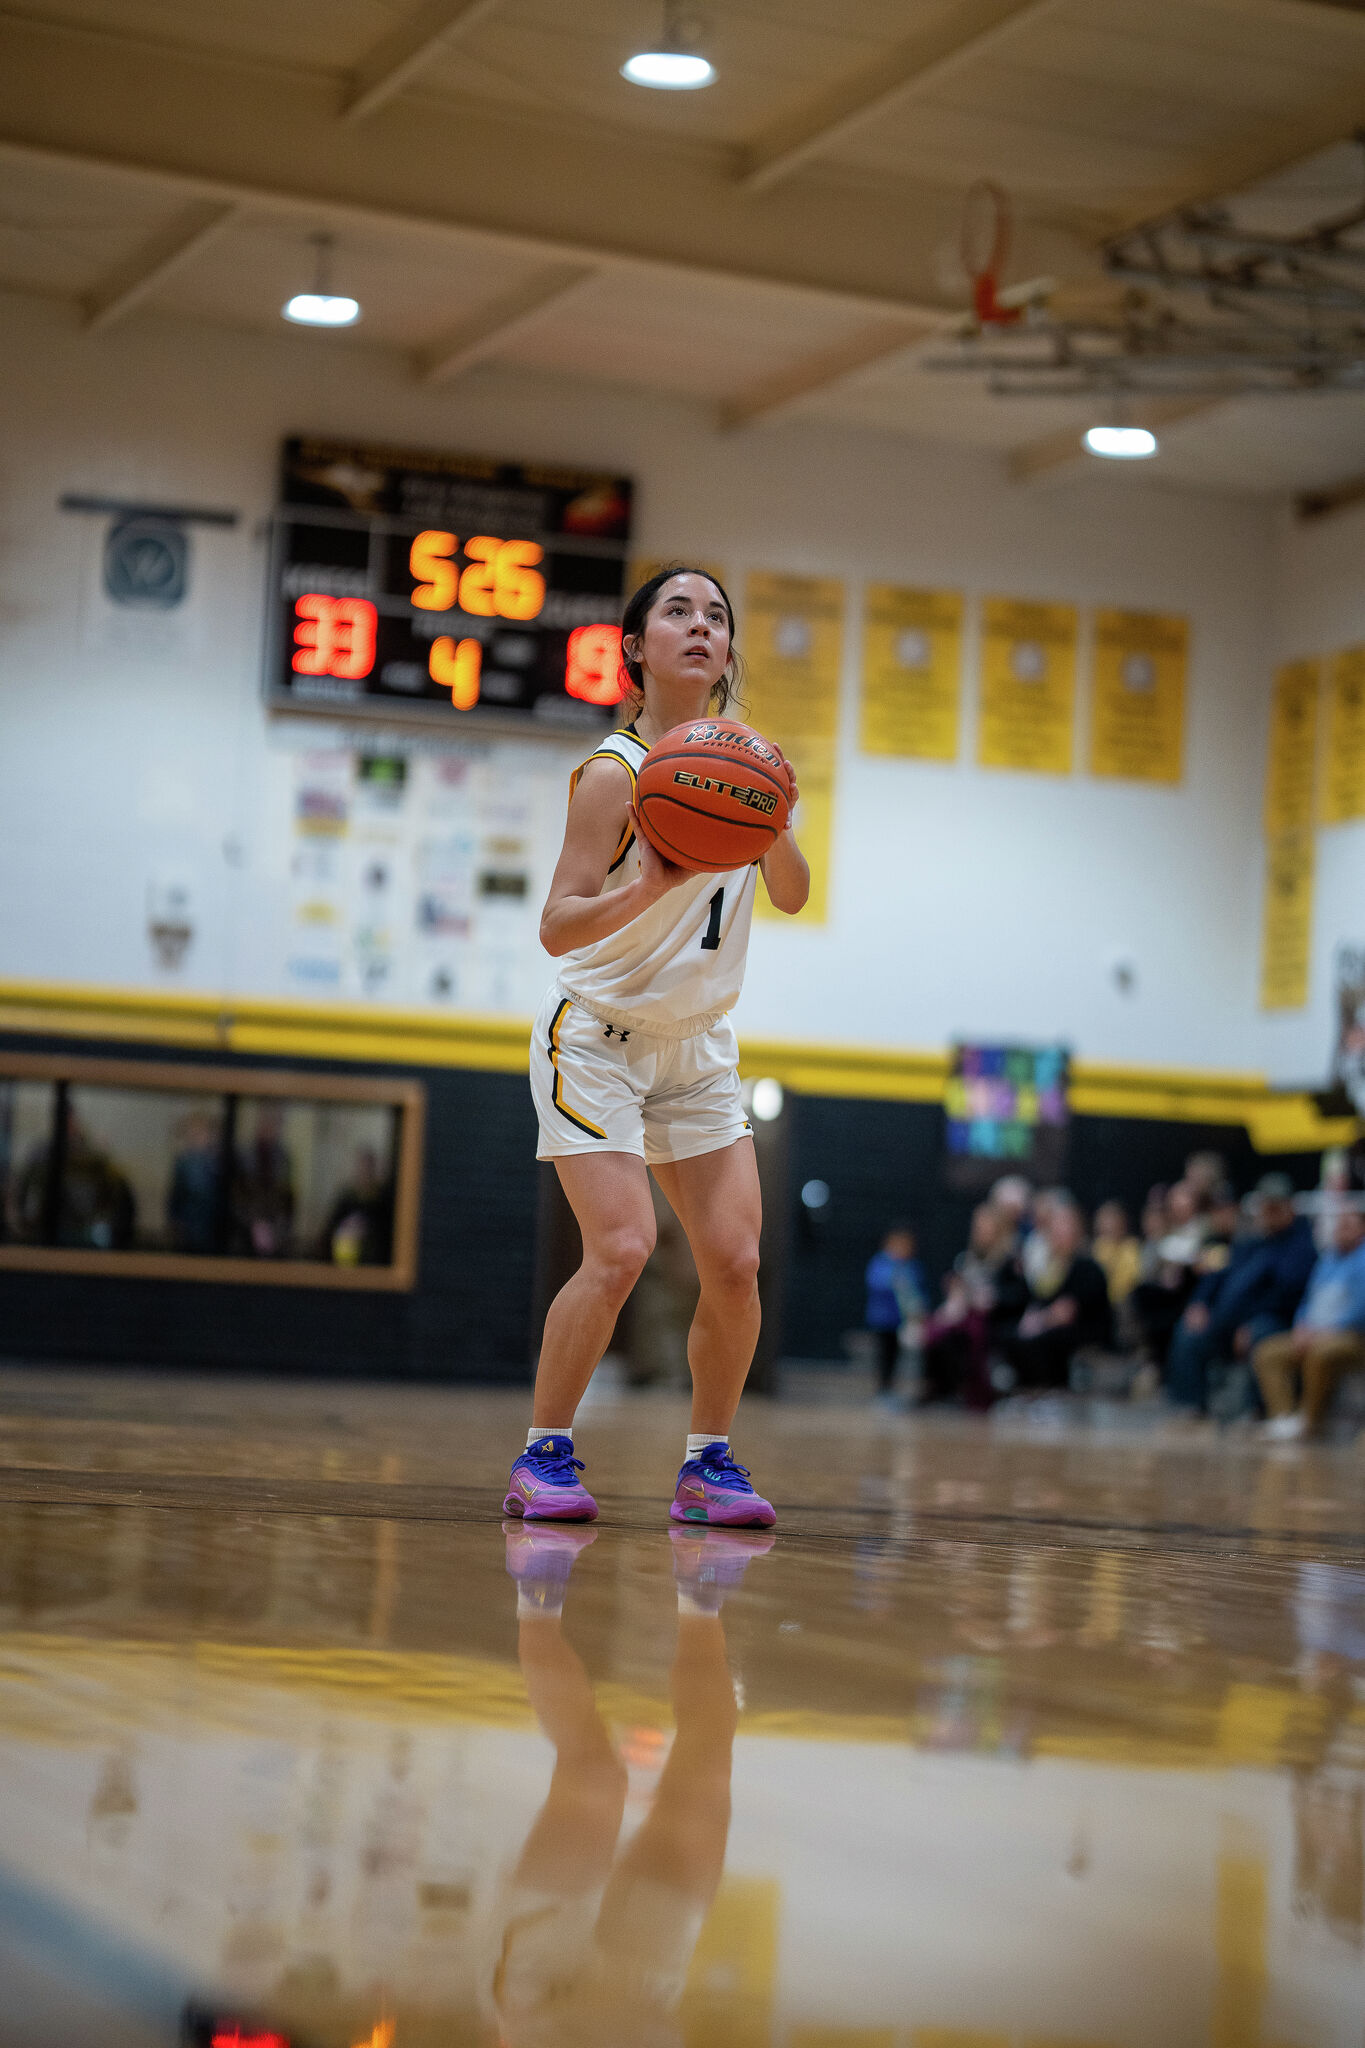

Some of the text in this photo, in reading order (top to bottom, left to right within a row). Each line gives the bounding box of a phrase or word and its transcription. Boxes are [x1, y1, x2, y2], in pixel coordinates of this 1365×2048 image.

[293, 594, 377, 679] 33
[429, 636, 483, 711] 4
[684, 725, 780, 768] Baden
[703, 742, 766, 764] PERFECTION
[673, 771, 777, 816] ELITE PRO
[701, 887, 724, 950] 1
